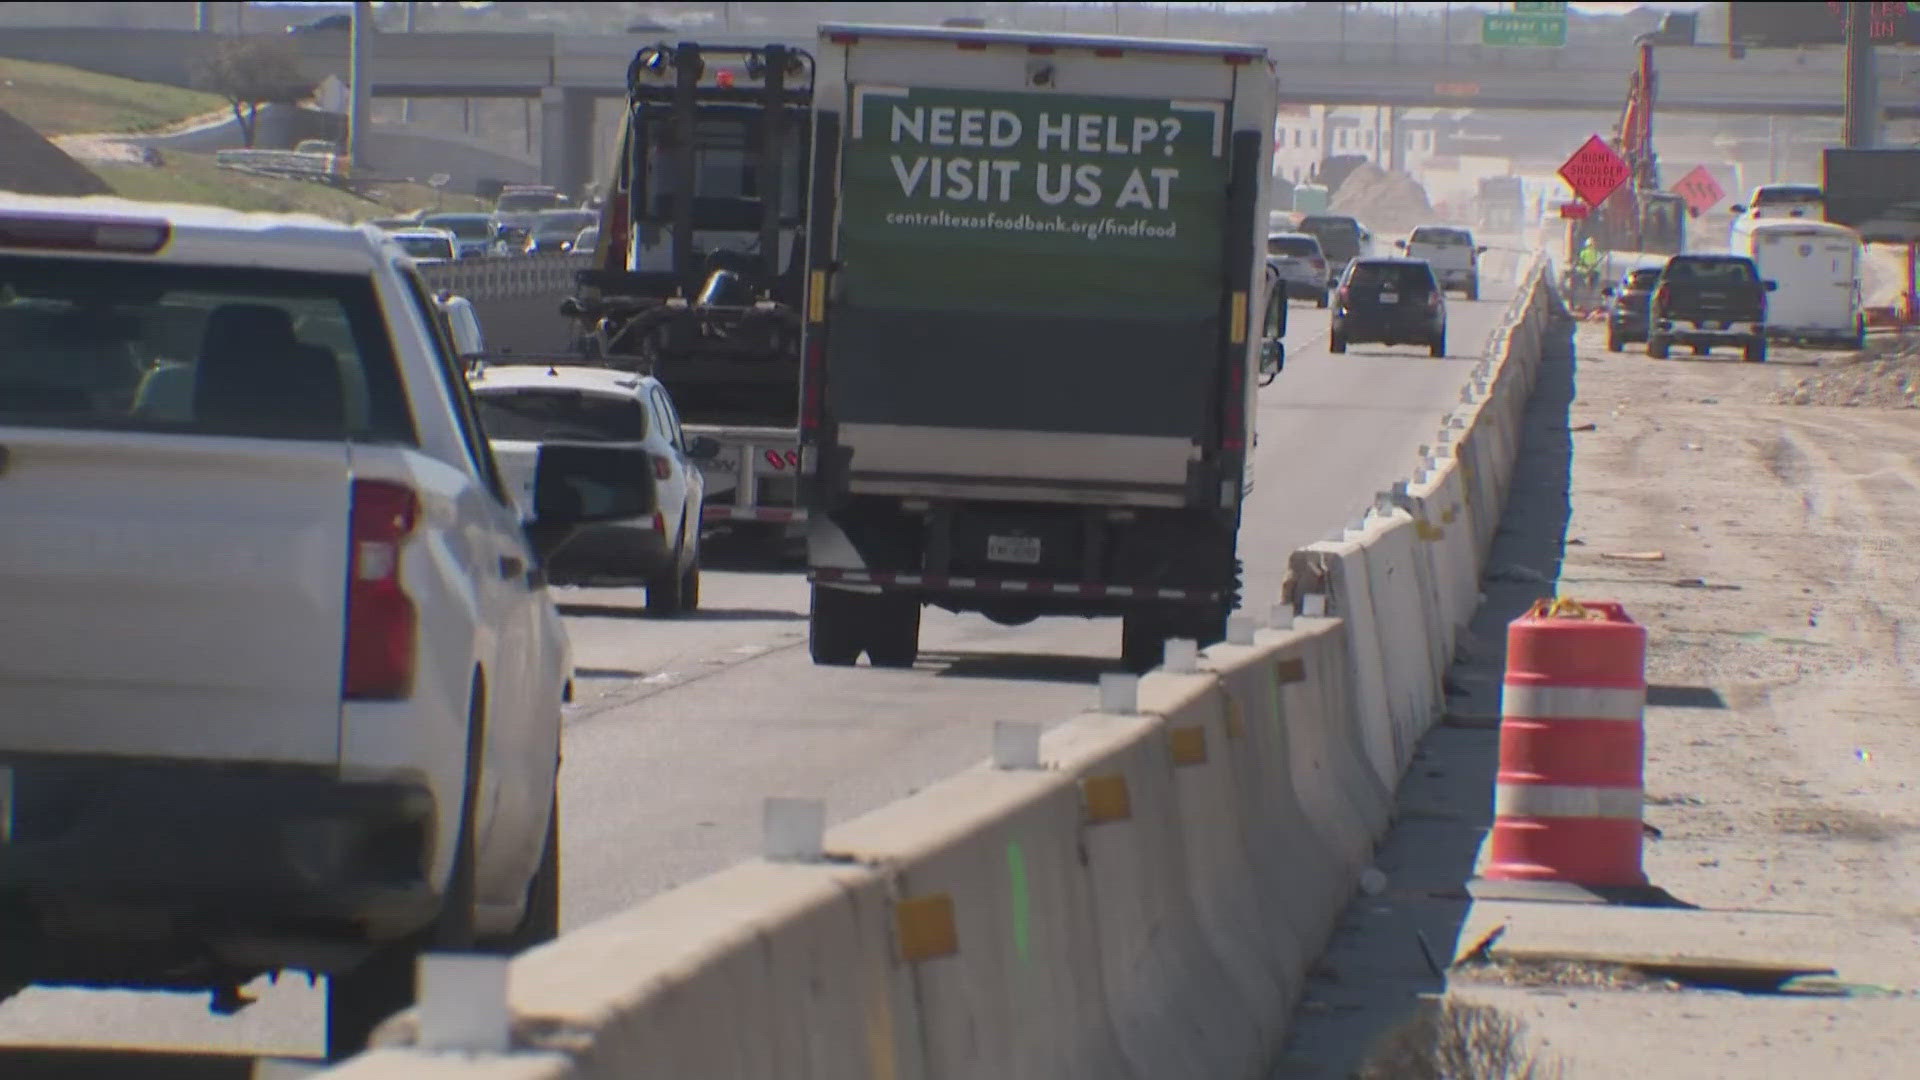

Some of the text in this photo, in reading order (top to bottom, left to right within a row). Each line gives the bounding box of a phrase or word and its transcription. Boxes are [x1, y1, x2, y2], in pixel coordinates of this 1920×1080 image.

[890, 105, 1182, 156] NEED HELP?
[1581, 153, 1610, 163] RIGHT
[1570, 165, 1623, 176] SHOULDER
[890, 155, 1179, 210] VISIT US AT
[1576, 178, 1616, 188] CLOSED
[886, 209, 1177, 240] centraltexasfoodbank.org/findfood
